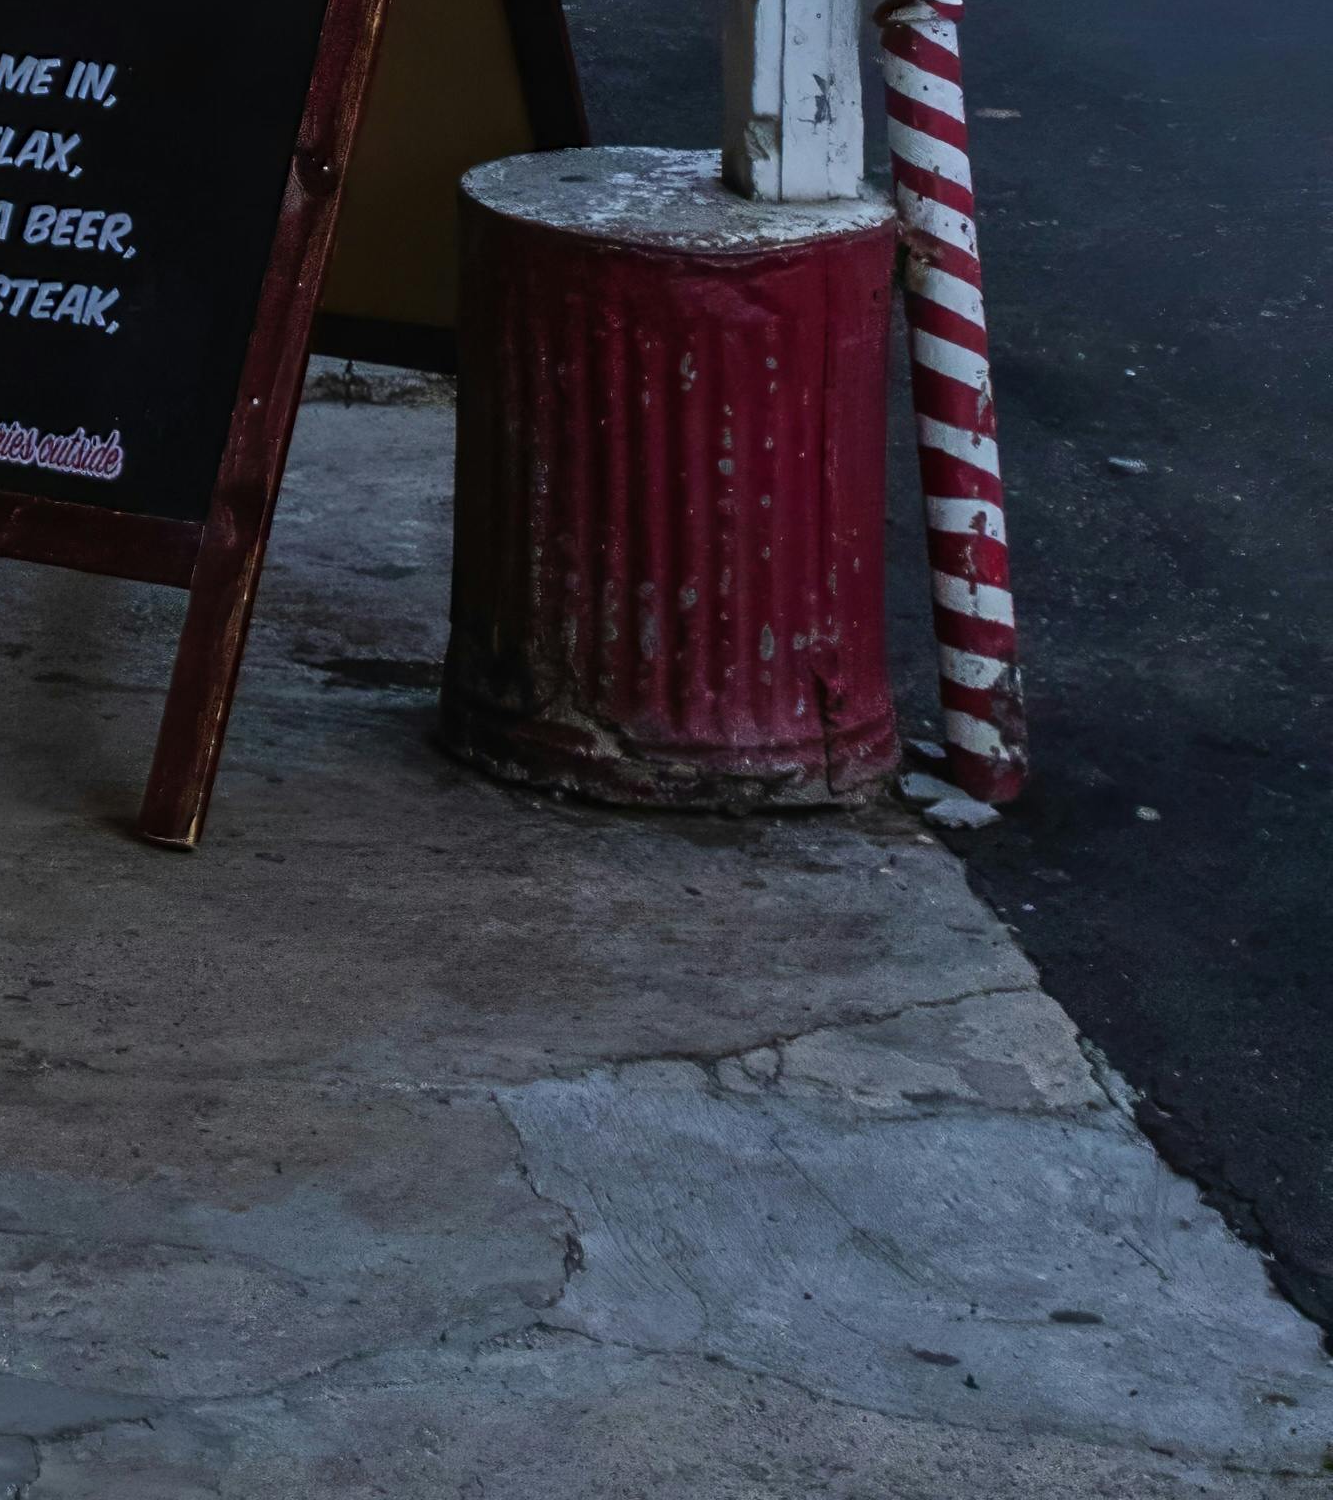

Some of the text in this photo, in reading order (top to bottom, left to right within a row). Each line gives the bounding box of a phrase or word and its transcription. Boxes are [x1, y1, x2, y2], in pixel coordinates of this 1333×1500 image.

[65, 61, 118, 106] IN,
[24, 205, 137, 259] BEER,
[37, 426, 125, 481] outside
